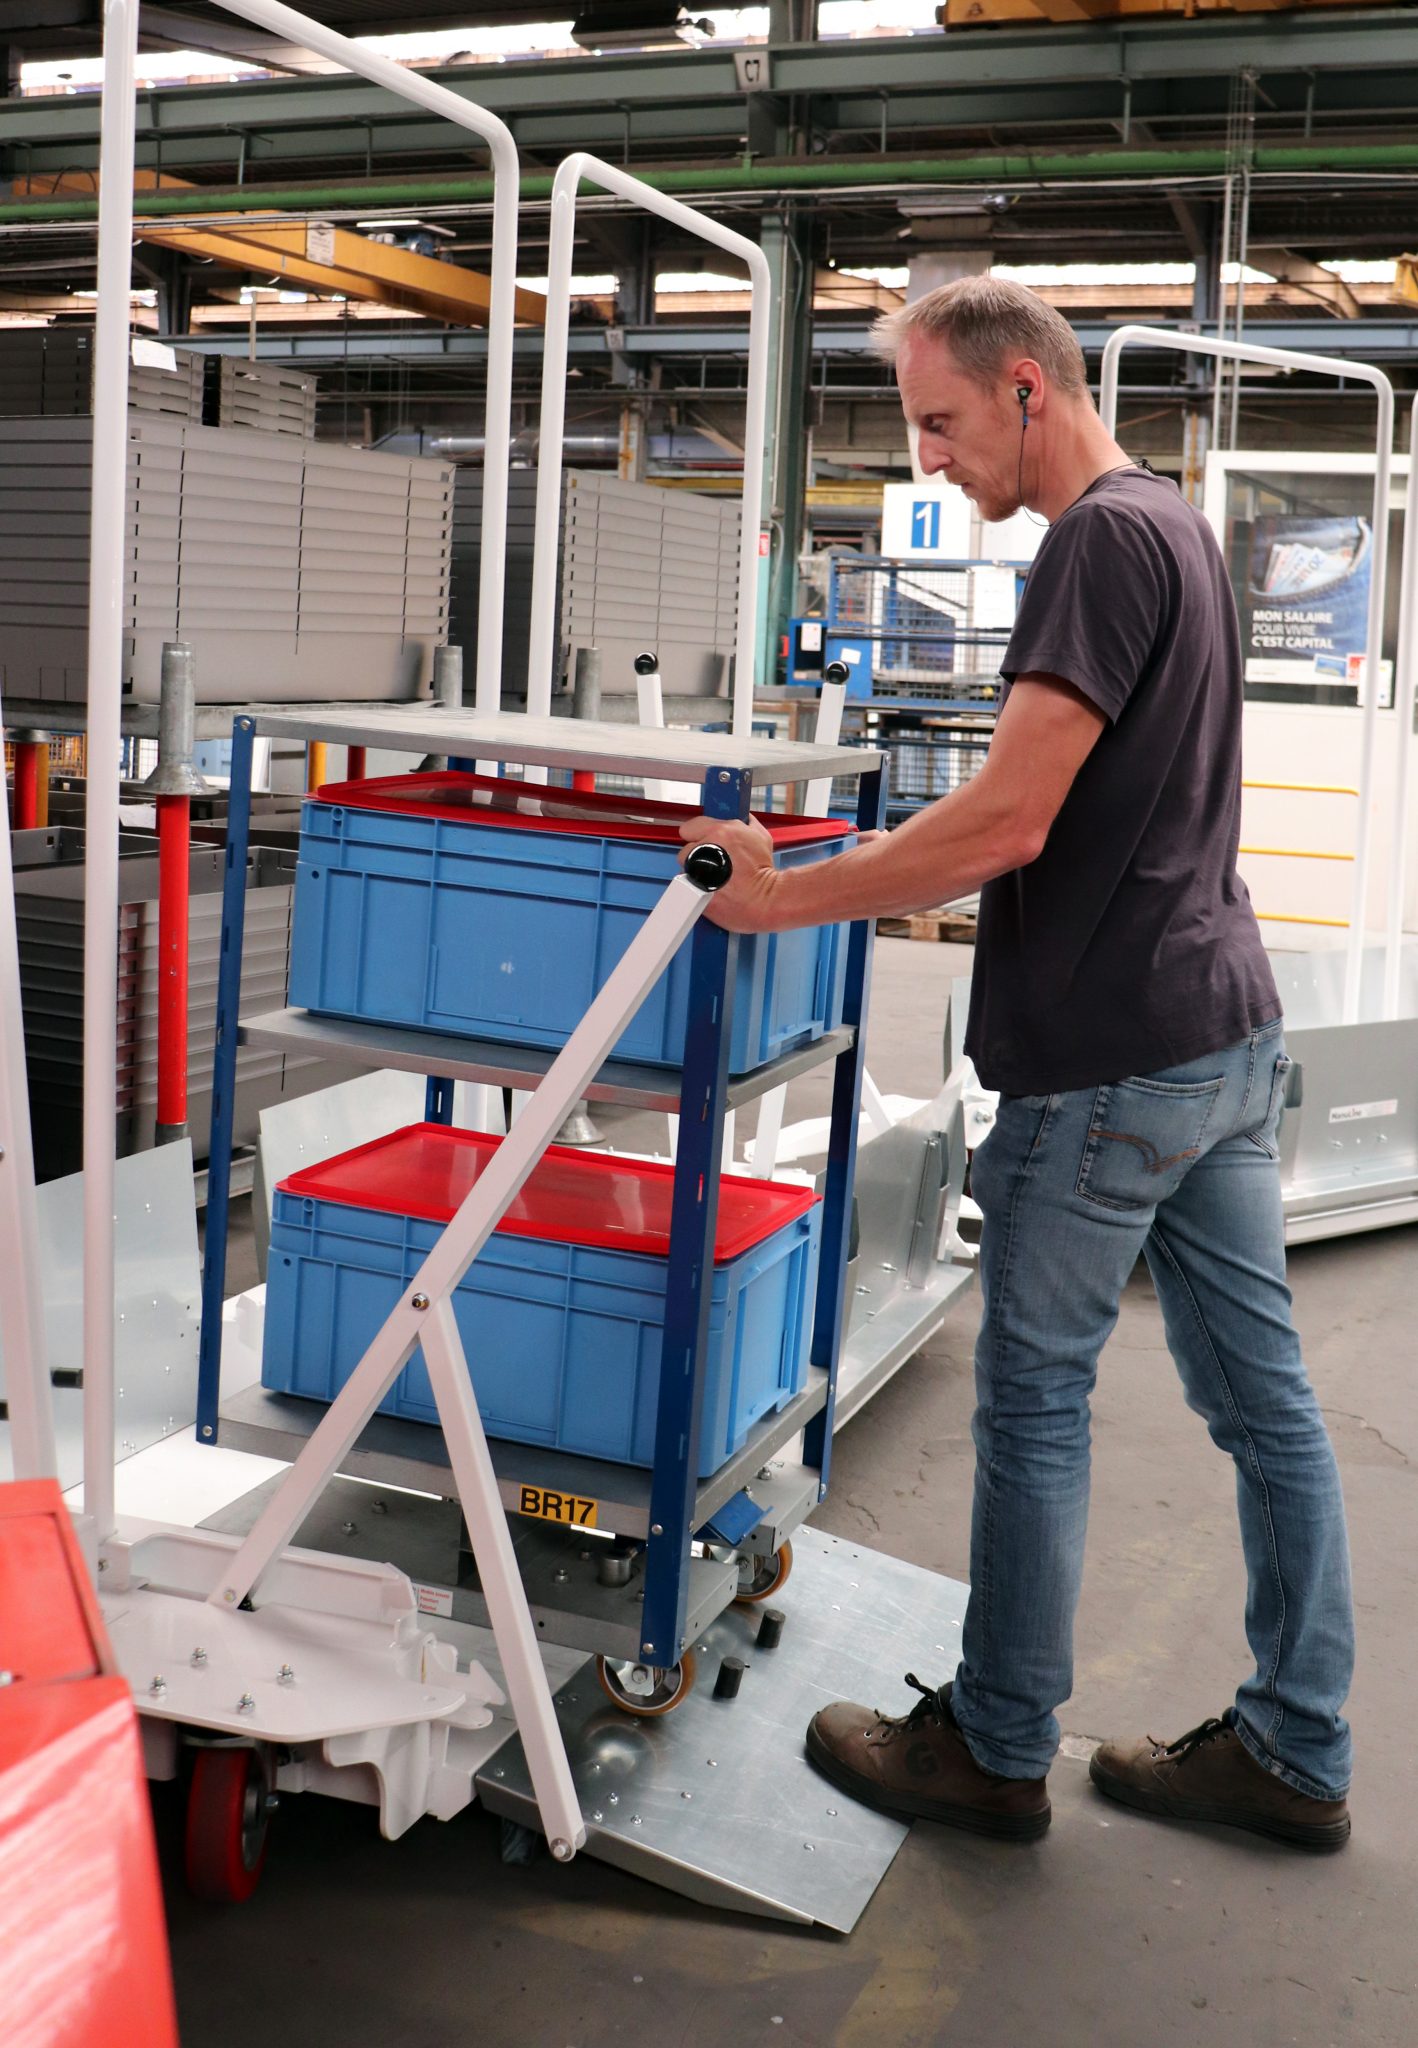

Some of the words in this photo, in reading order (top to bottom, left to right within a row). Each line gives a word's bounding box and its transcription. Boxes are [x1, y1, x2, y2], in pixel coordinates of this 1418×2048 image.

[916, 502, 934, 548] 1
[1252, 610, 1283, 623] MON
[1284, 611, 1333, 624] SALAIRE
[1252, 623, 1285, 635] POUR
[1285, 625, 1316, 636] VIVRE
[1251, 636, 1284, 648] C'EST
[1285, 637, 1335, 649] CAPITAL
[520, 1487, 595, 1525] BR17
